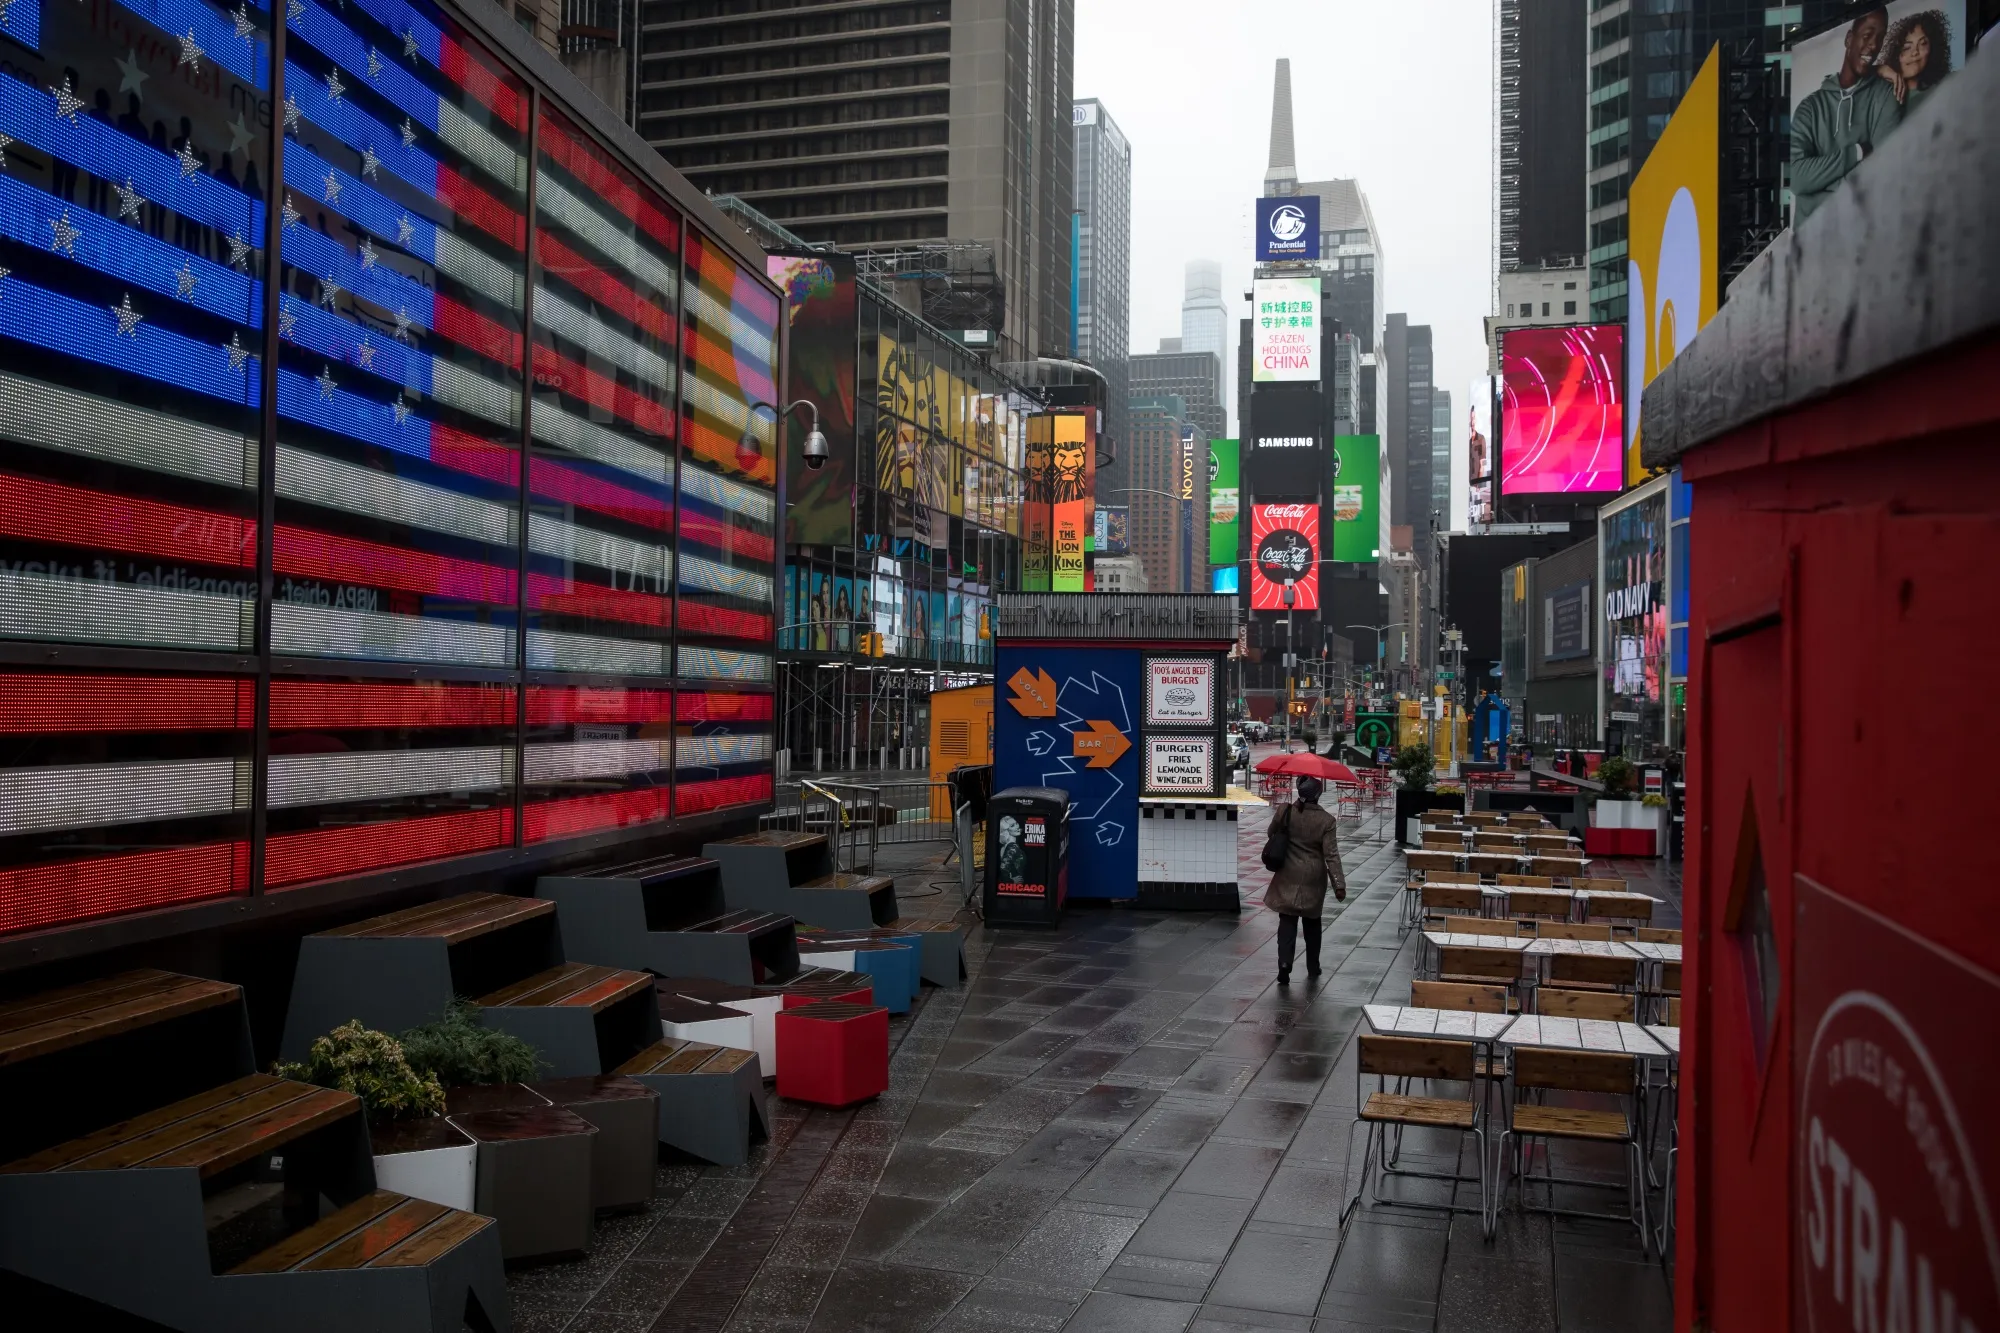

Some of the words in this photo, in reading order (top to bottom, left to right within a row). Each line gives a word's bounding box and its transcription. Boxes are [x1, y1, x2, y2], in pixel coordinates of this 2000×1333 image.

[1269, 241, 1306, 249] Prudential
[1261, 302, 1313, 314] 新城控股
[1261, 316, 1313, 329] 守护幸福
[1269, 334, 1304, 343] SEAZEN
[1262, 345, 1311, 354] HOLDINGS
[1263, 355, 1309, 369] CHINA
[1258, 437, 1313, 447] SAMSUNG
[1181, 433, 1193, 500] NOVOTEL
[1059, 530, 1076, 539] THE
[1094, 512, 1104, 548] FROZEN
[1056, 540, 1079, 554] LION
[1054, 554, 1083, 572] KING
[1605, 588, 1624, 621] OLD
[1624, 582, 1651, 616] NAVY
[1154, 666, 1170, 675] 100%
[1171, 666, 1190, 675] ANGUS
[1192, 666, 1207, 675] BEEF
[1161, 676, 1199, 685] BURGERS
[1019, 677, 1048, 709] LOCAL
[1177, 709, 1203, 717] Burger
[1078, 740, 1102, 748] BAR
[1155, 745, 1204, 753] BURGERS
[1168, 756, 1191, 764] FRIES
[1157, 766, 1202, 774] LEMONADE
[1156, 776, 1203, 784] WINE/BEER
[1024, 823, 1045, 834] ERIKA
[1024, 834, 1045, 844] JAYNE
[997, 882, 1045, 892] CHICAGO
